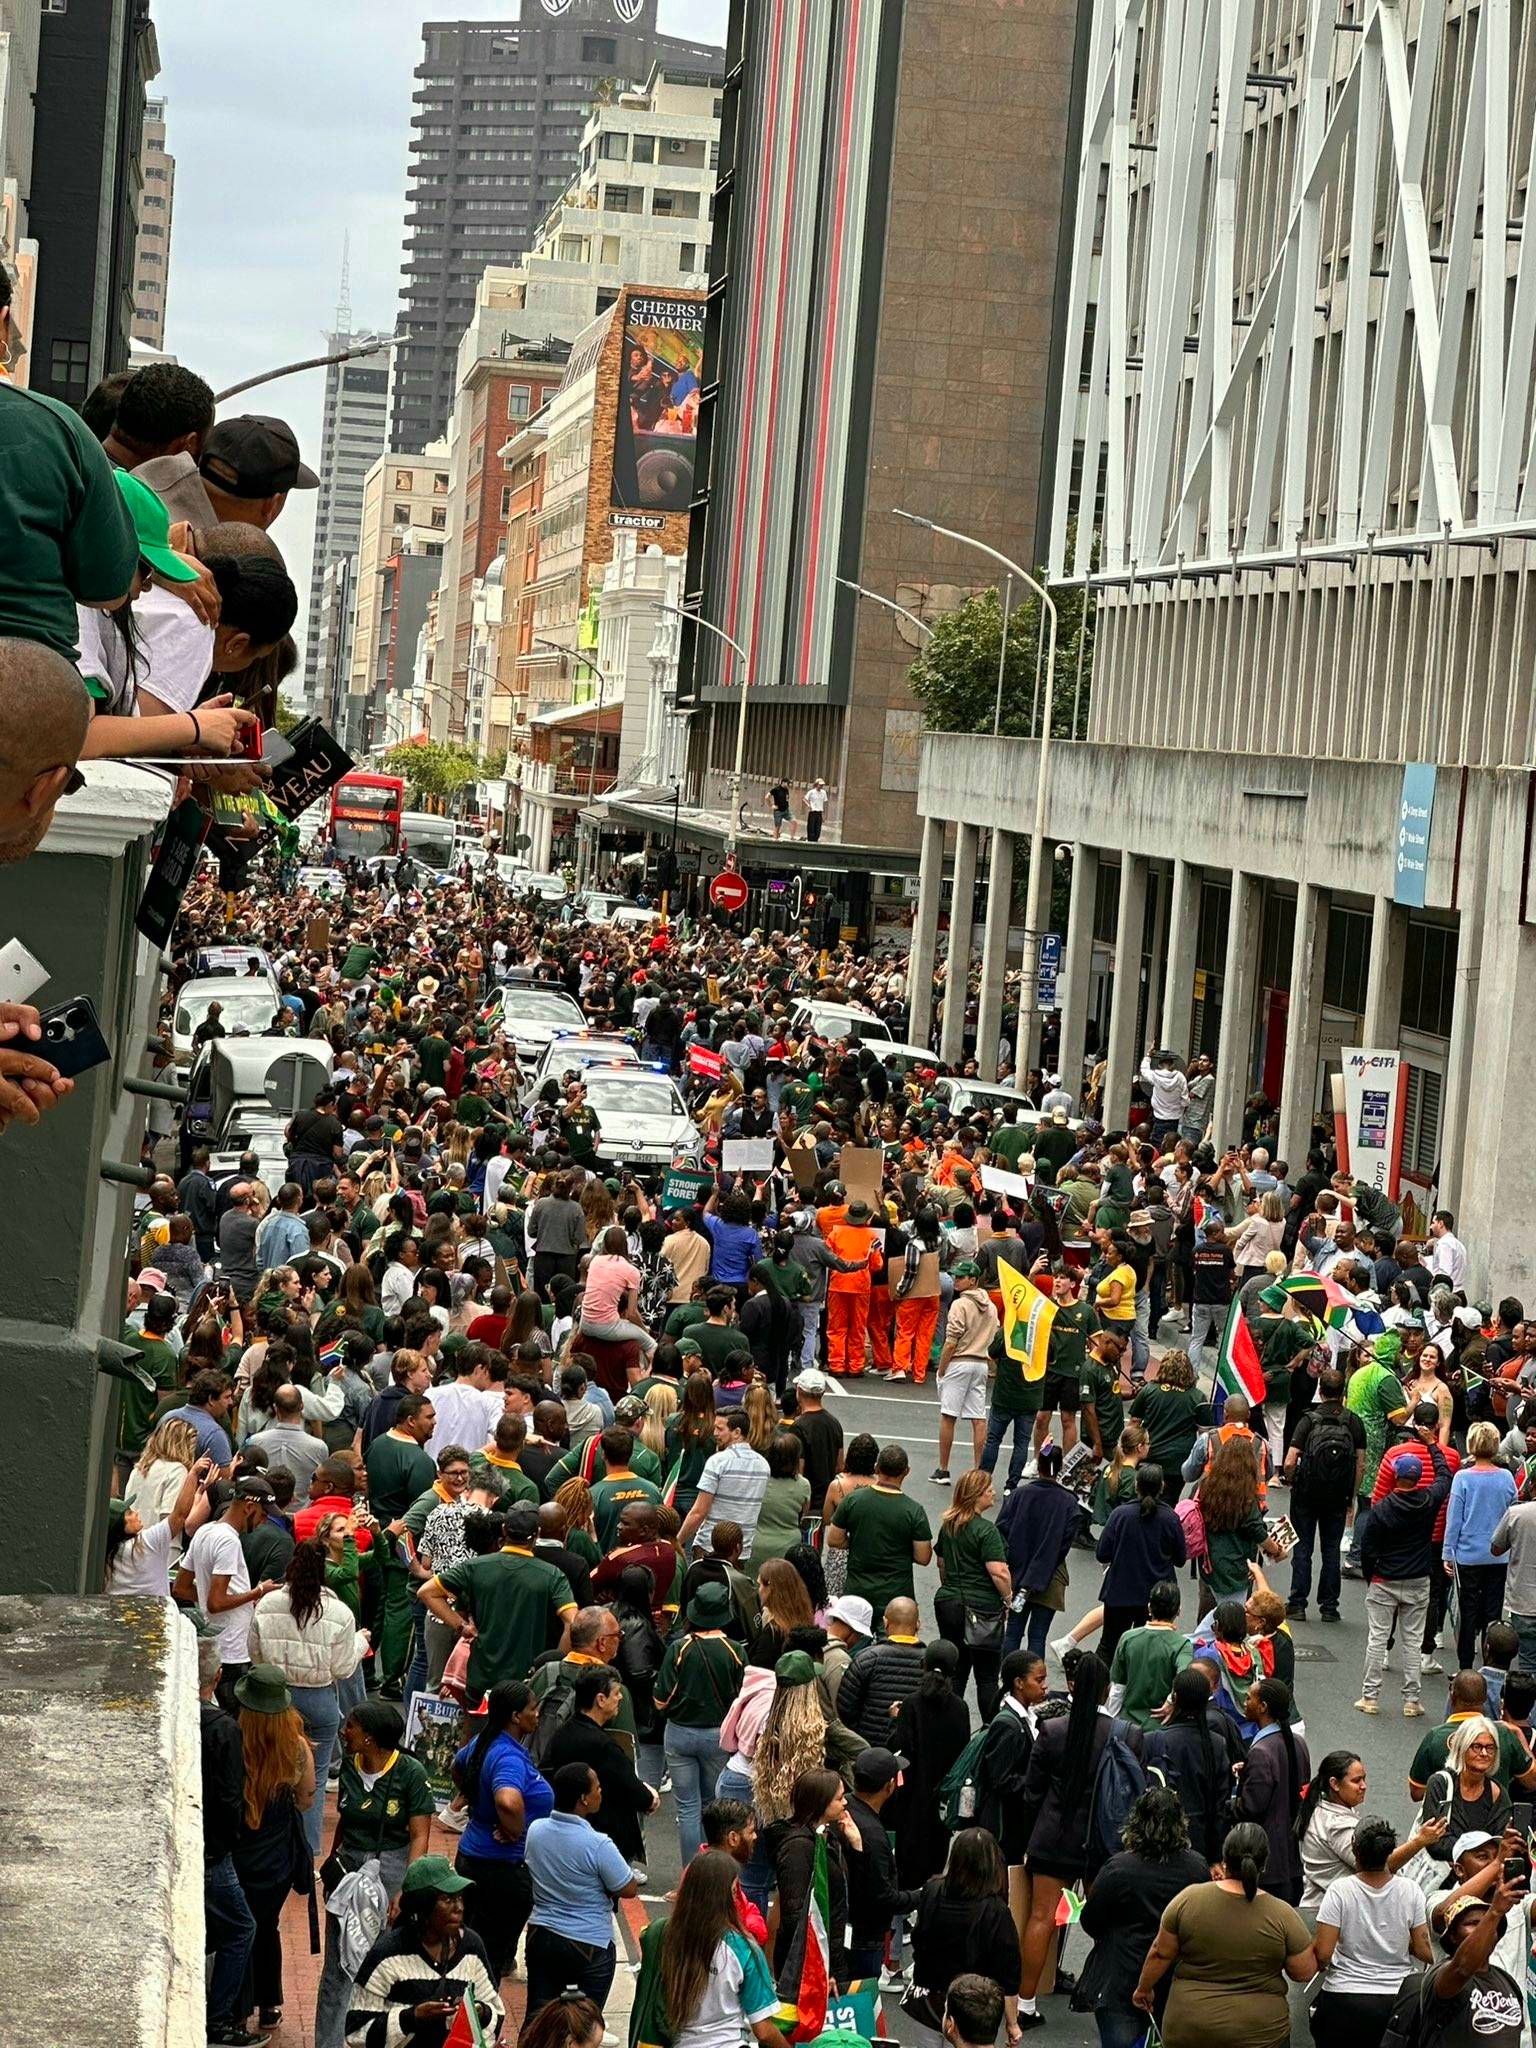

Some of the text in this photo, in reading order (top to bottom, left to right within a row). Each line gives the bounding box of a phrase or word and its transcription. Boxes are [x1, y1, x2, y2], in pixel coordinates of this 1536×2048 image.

[630, 299, 696, 318] CHEERS
[629, 313, 703, 332] SUMMER
[613, 513, 661, 528] tractor
[1046, 937, 1056, 950] P
[1350, 1055, 1396, 1078] MyCITI
[614, 1490, 646, 1500] DHL
